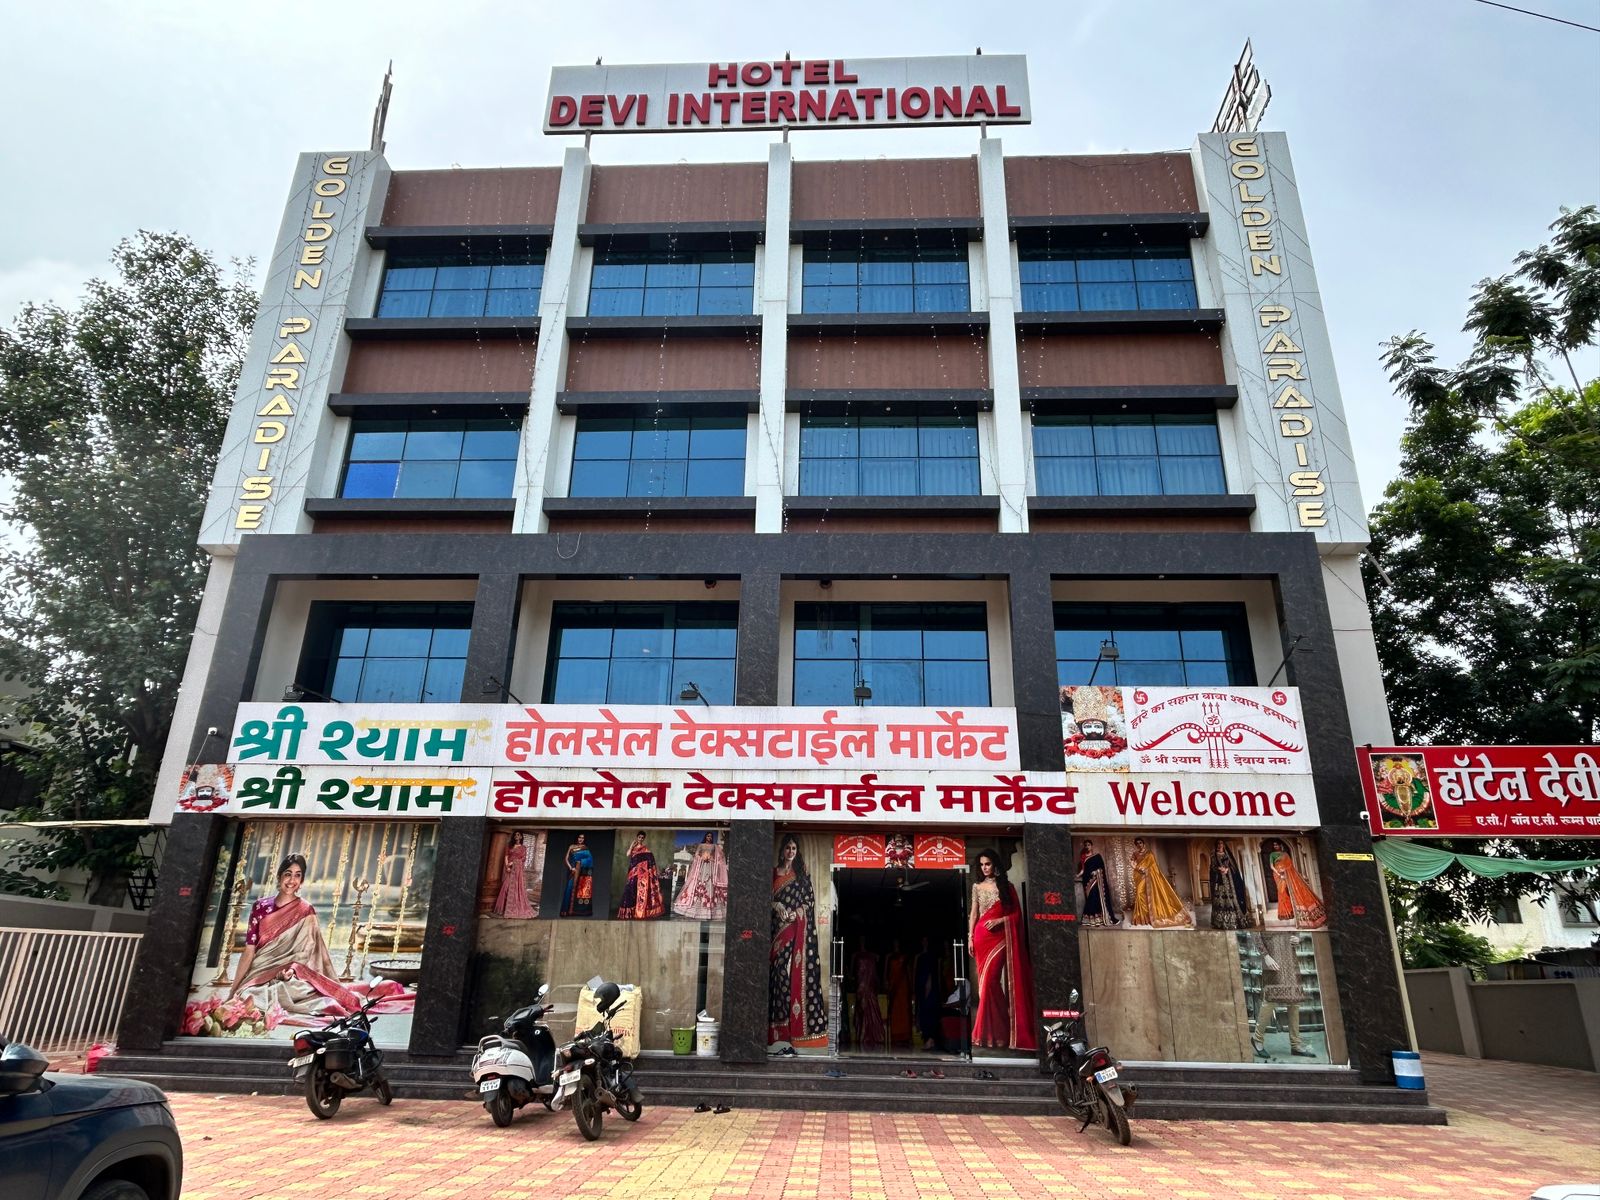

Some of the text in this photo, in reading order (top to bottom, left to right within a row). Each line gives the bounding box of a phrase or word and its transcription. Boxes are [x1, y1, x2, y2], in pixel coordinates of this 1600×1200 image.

[708, 60, 858, 87] HOTEL
[549, 84, 1021, 126] DEVI INTERNATIONAL
[234, 155, 352, 531] GOLDEN PARADISE
[1228, 137, 1329, 528] GOLDEN PARADISE
[232, 705, 308, 762] श्री
[1131, 692, 1299, 730] हारे का सहारा बाबा श्याम हमारा
[504, 707, 1010, 766] होलसेल टेक्सटाईल मार्केट
[1154, 754, 1169, 765] श्री
[1171, 755, 1202, 765] श्याम
[1233, 754, 1265, 767] देवाय
[1433, 753, 1533, 806] हॉटेल
[235, 766, 306, 810] श्री
[493, 770, 1080, 818] होलसेल टेक्सटाईल मार्केट
[1108, 780, 1297, 818] Welcome
